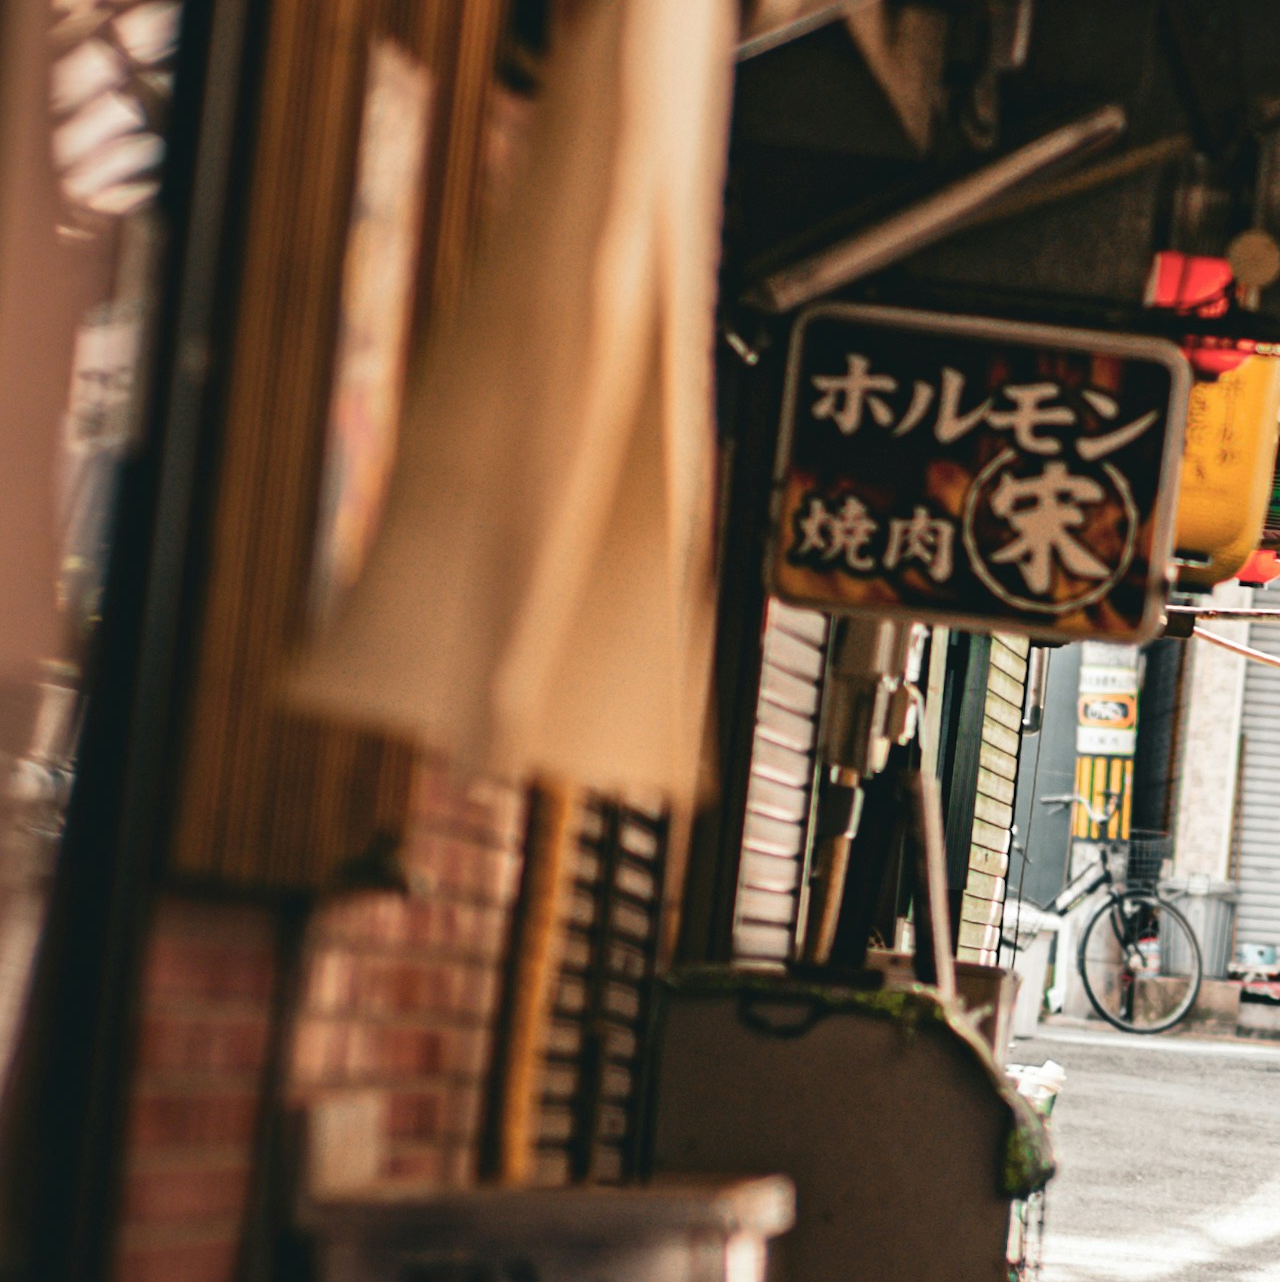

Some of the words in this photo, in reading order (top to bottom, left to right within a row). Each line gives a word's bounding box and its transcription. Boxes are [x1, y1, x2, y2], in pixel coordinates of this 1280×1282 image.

[811, 352, 1159, 461] ホルモン
[798, 495, 955, 583] 焼肉
